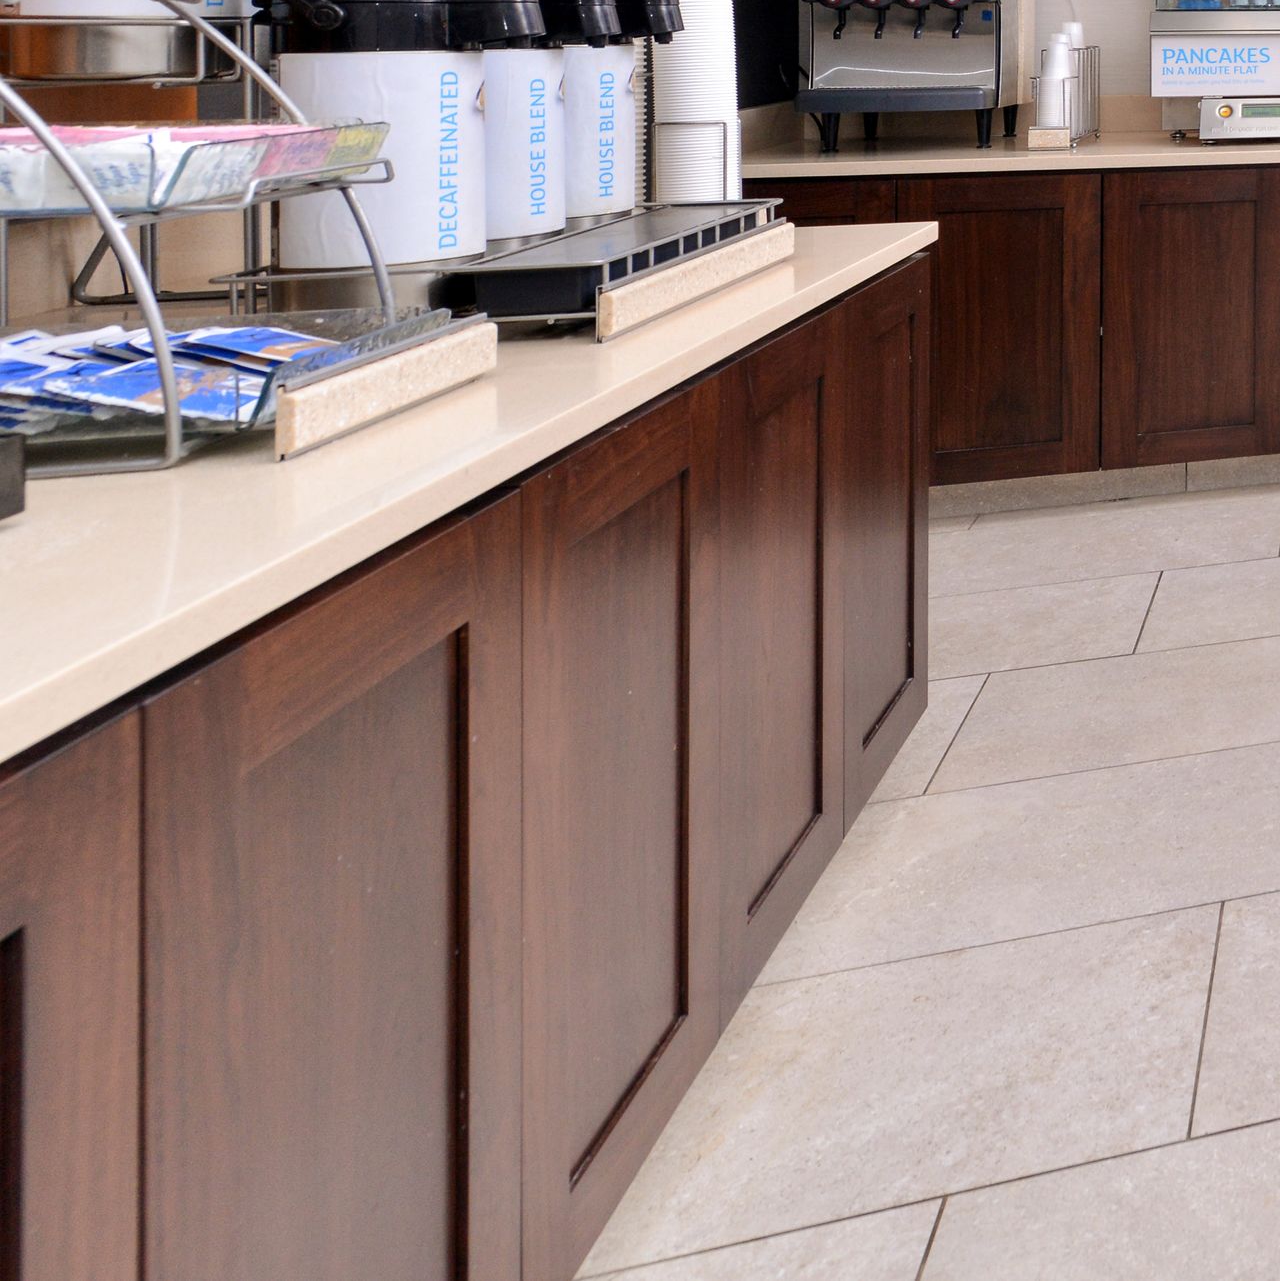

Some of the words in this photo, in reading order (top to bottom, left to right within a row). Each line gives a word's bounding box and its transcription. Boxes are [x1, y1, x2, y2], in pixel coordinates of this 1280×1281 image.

[1162, 47, 1271, 65] PANCAKES
[1162, 66, 1174, 76] IN
[1177, 66, 1185, 75] A
[1188, 65, 1230, 75] MINUTE
[1233, 65, 1259, 75] FLAT
[529, 78, 546, 144] BLEND
[600, 72, 615, 132] BLEND
[438, 70, 459, 250] DECAFFEINATED
[530, 150, 546, 216] HOUSE
[599, 137, 614, 197] HOUSE
